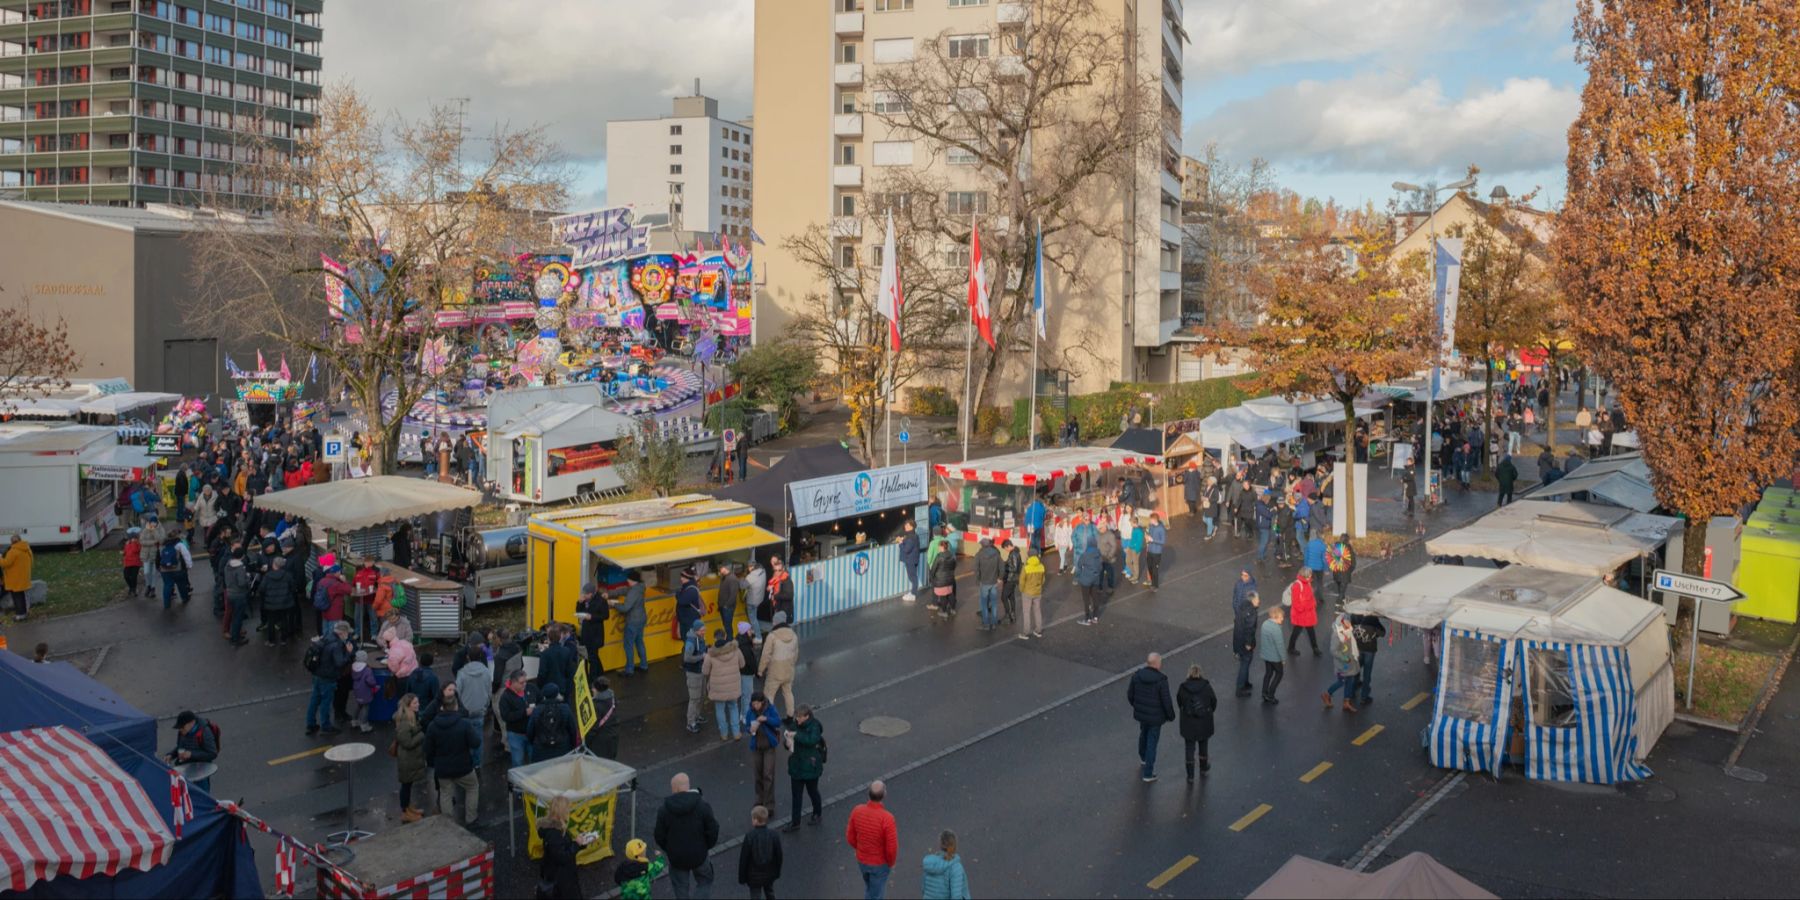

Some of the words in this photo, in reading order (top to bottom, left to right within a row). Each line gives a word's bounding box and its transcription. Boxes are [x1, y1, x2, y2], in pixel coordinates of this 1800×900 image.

[573, 224, 650, 267] DANCE
[330, 437, 338, 454] P
[813, 488, 841, 514] Gyros
[880, 473, 920, 503] Halloumi
[1674, 579, 1709, 594] Uschter
[1710, 586, 1722, 596] 77
